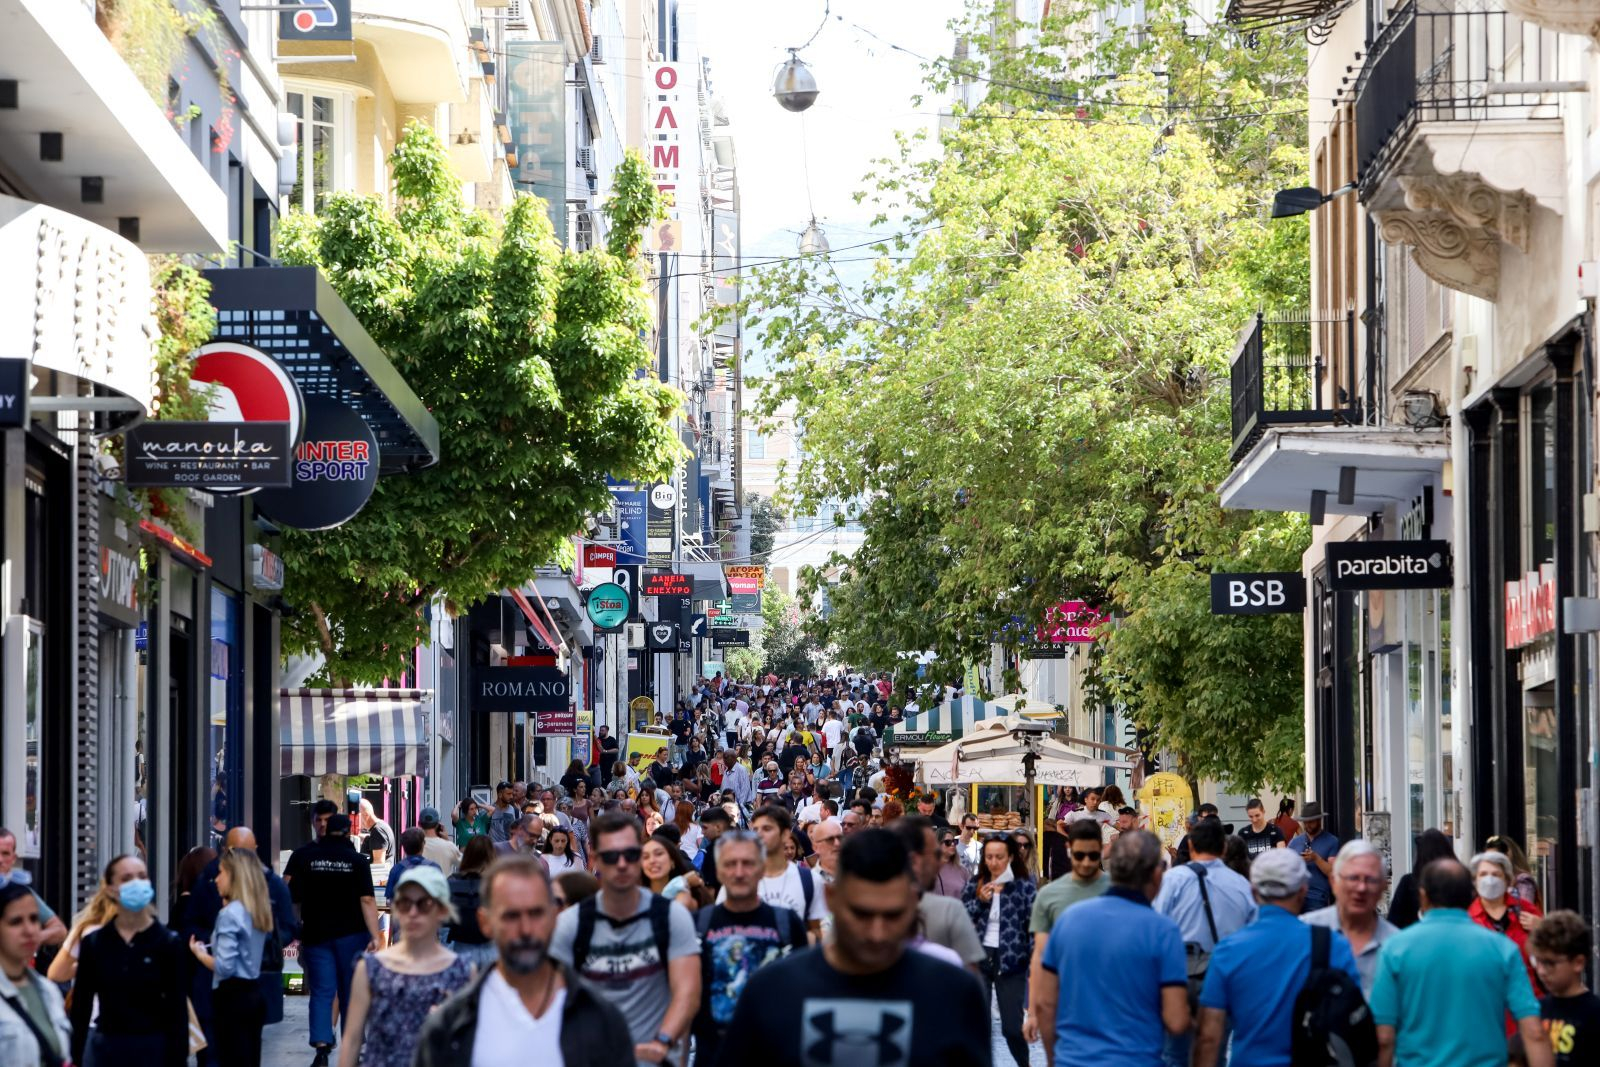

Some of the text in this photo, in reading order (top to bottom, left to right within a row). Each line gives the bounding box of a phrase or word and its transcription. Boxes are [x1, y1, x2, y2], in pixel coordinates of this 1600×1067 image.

[143, 428, 271, 456] manouka
[297, 440, 369, 461] INTER
[145, 462, 271, 470] WINE RESTAURANT BAR
[296, 460, 369, 481] SPORT
[654, 491, 673, 502] Big
[589, 552, 614, 561] CAMPER
[1337, 554, 1428, 579] parabita
[647, 586, 690, 594] ΕΝΕΧΥΡΟ
[1228, 579, 1286, 608] BSB
[482, 681, 565, 696] ROMANO
